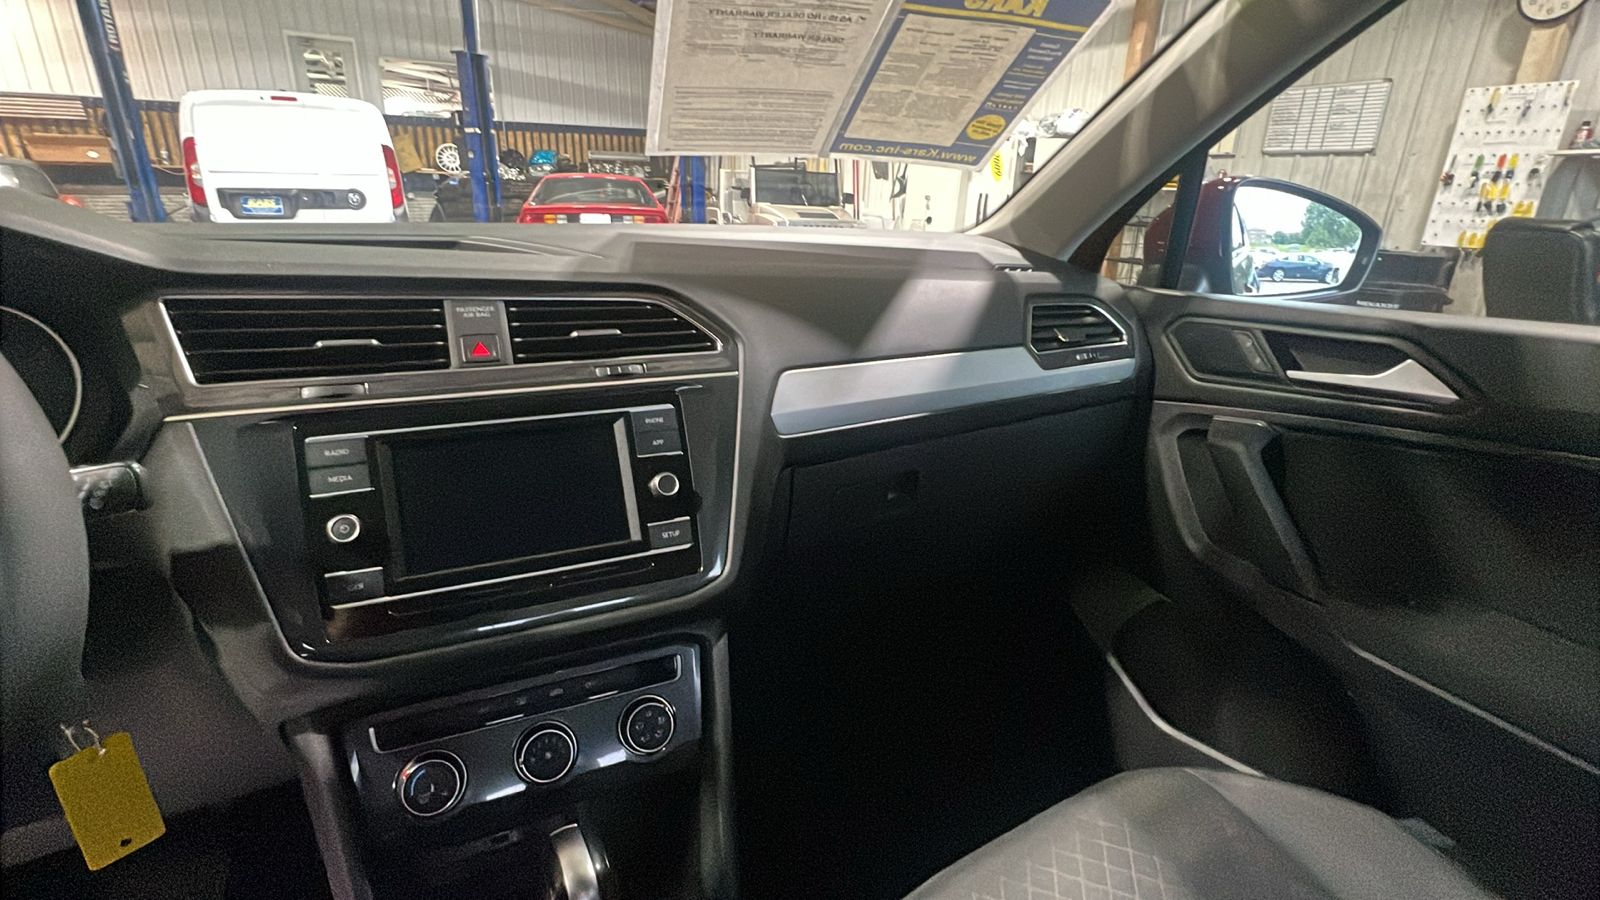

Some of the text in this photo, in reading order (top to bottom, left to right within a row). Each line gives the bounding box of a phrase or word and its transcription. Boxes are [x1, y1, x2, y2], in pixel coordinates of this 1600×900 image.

[645, 416, 664, 424] PHONE
[324, 448, 350, 456] RADIO
[327, 474, 353, 483] MEDIA
[661, 529, 680, 539] SETUP
